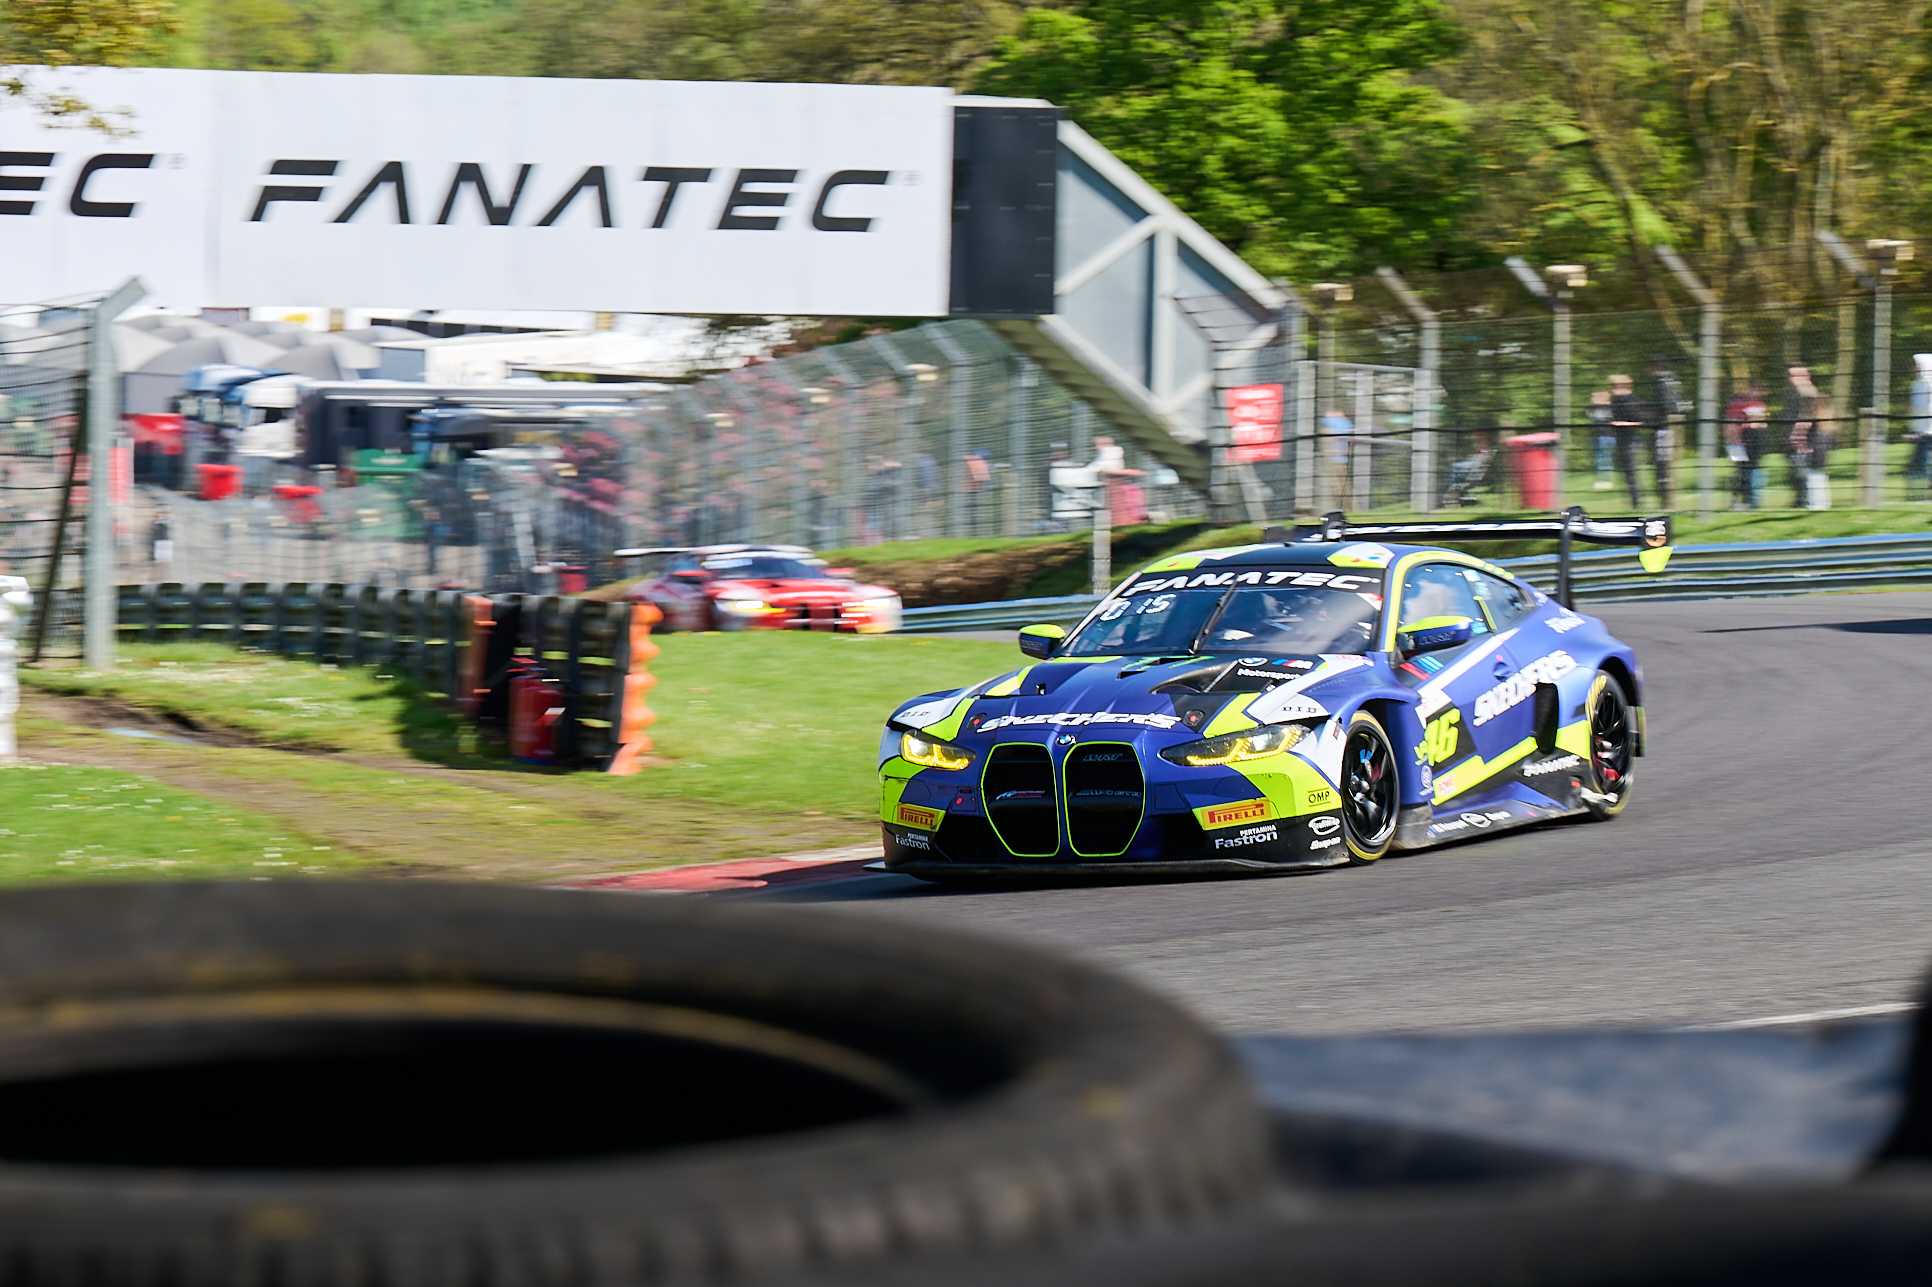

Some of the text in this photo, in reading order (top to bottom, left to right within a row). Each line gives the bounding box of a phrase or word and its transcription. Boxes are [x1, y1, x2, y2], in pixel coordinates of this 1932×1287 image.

[250, 160, 890, 232] FANATEC
[1122, 571, 1372, 597] FANATEC
[1308, 790, 1330, 804] OMP
[1207, 802, 1265, 824] PIRELLI
[1239, 824, 1278, 837] PERTAMINA
[895, 834, 931, 851] Fastron
[1215, 831, 1279, 850] Fastron
